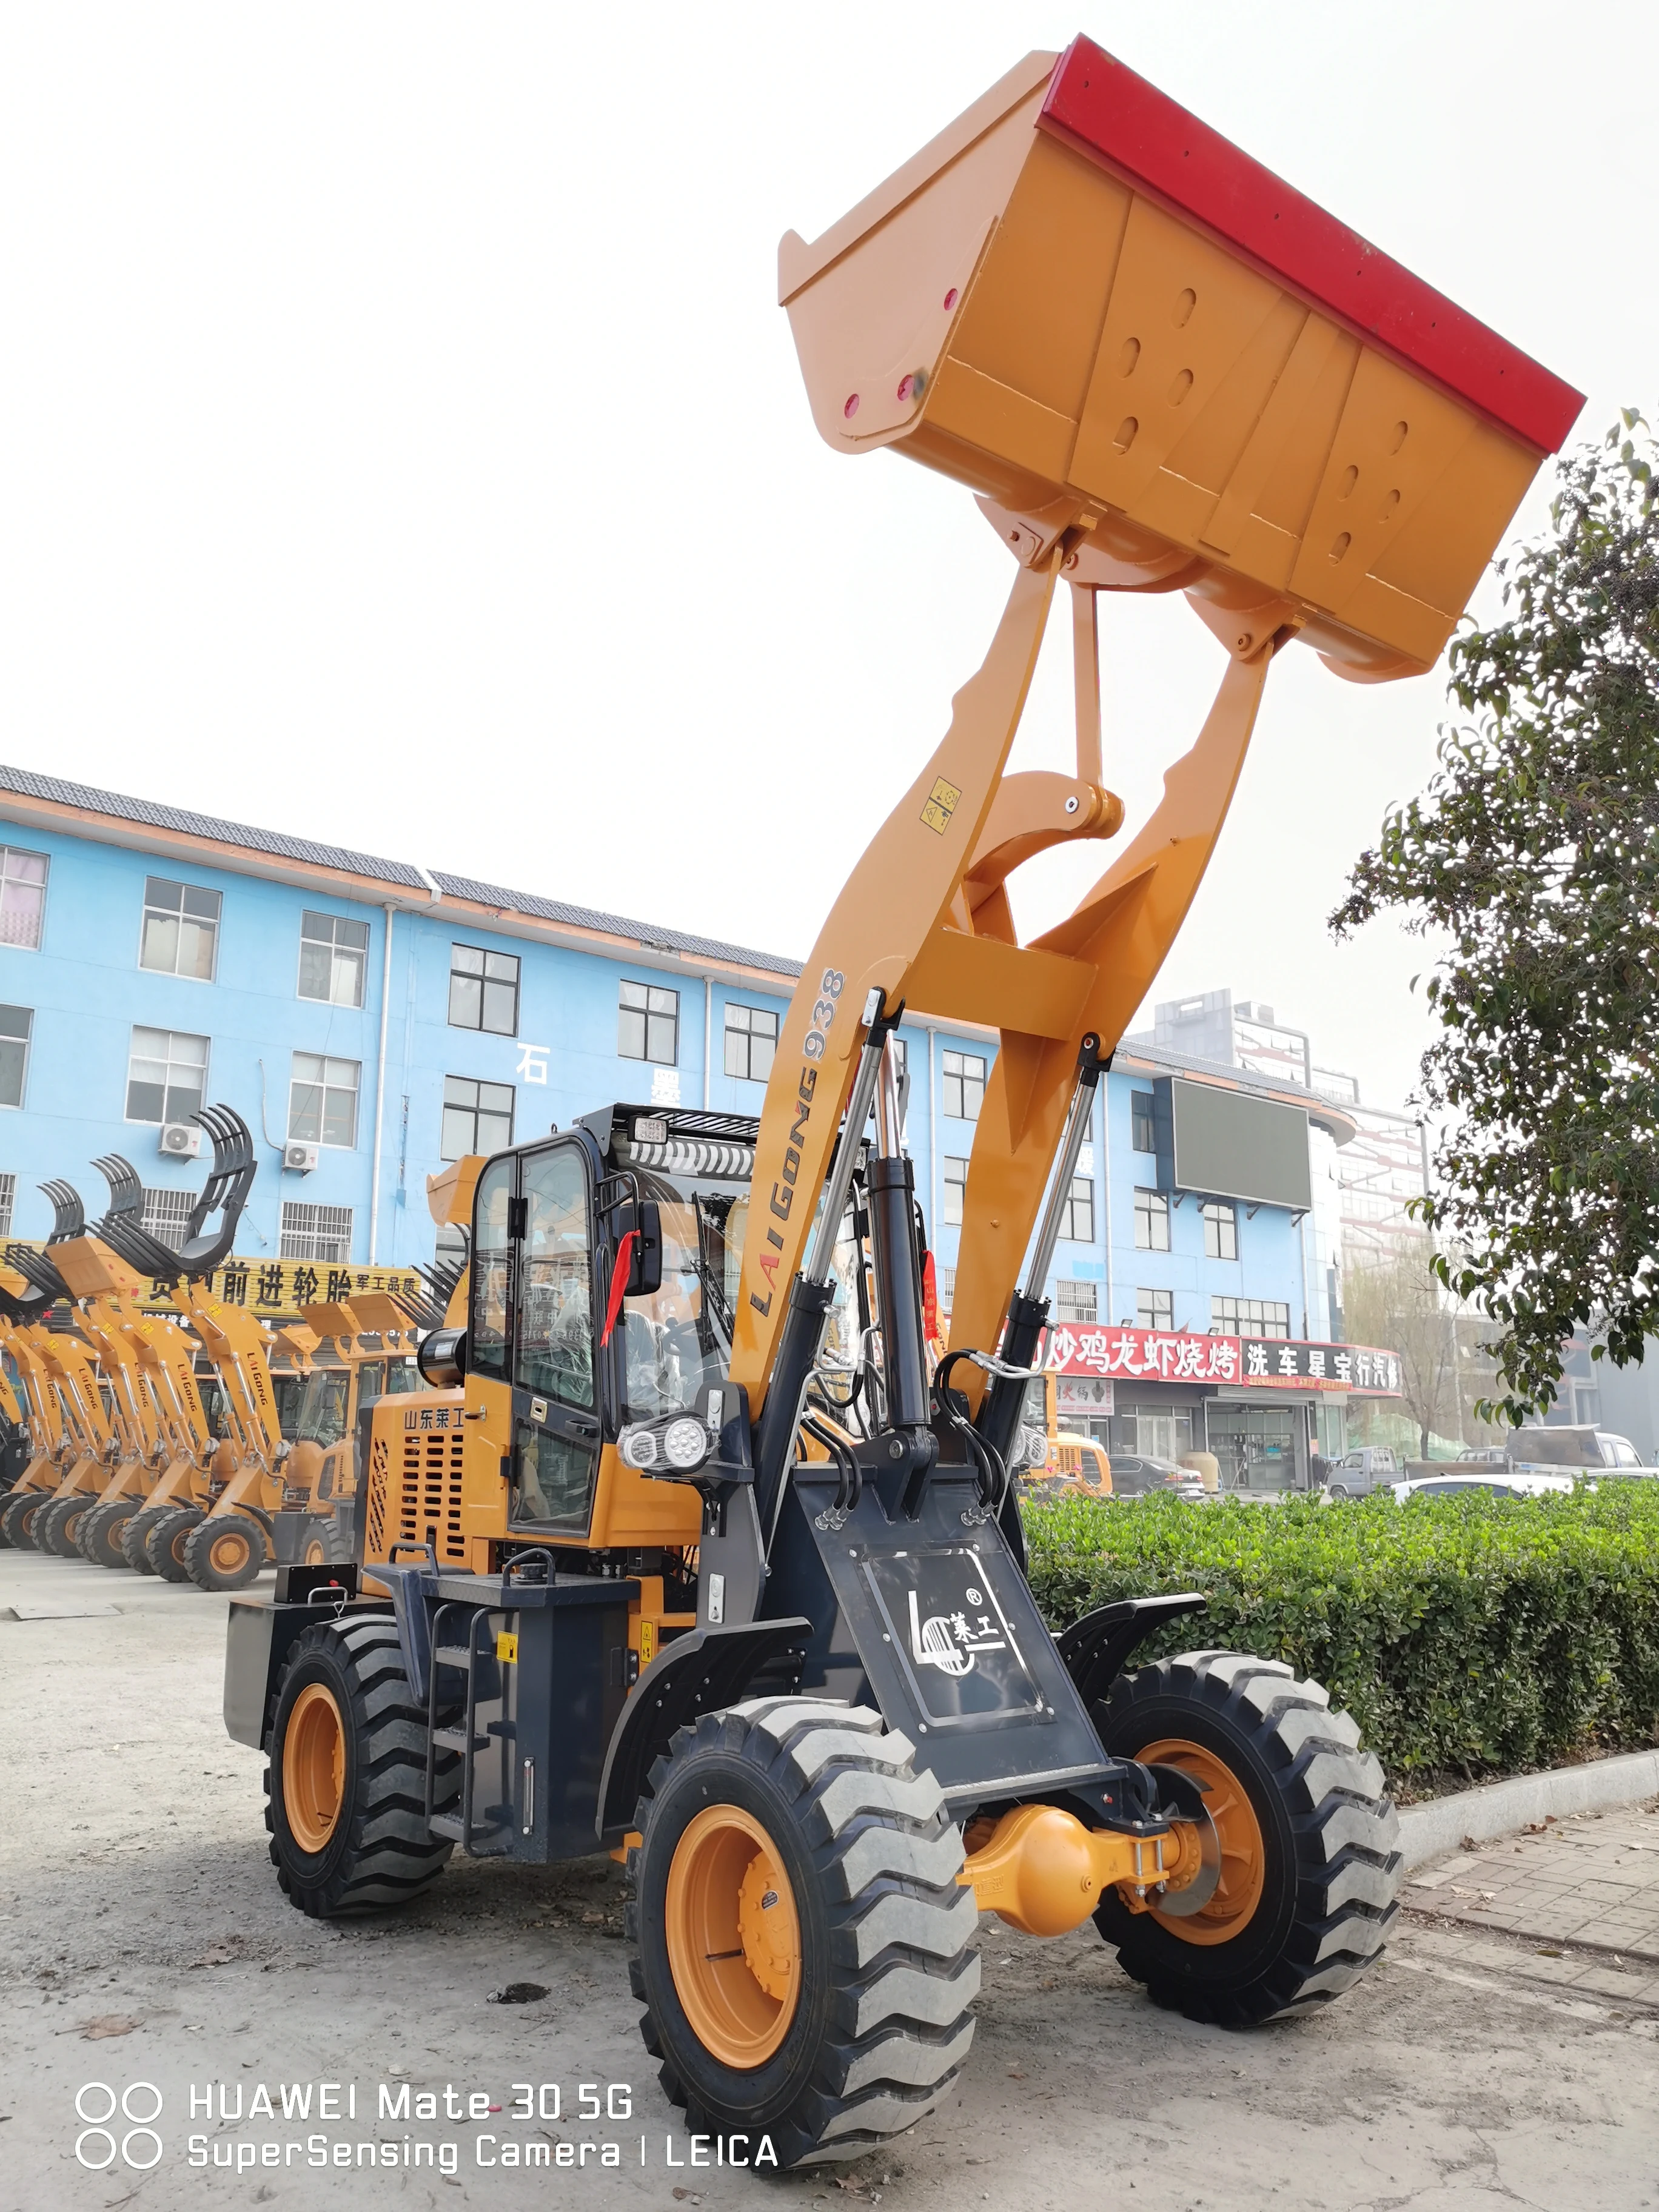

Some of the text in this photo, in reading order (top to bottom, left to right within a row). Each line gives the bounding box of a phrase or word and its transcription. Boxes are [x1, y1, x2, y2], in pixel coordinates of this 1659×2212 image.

[804, 968, 845, 1061] 938
[516, 1042, 551, 1085] 石
[651, 1068, 681, 1108] 墨
[149, 1261, 417, 1307] 前进轮胎 军工品质
[404, 1407, 464, 1430] 山东莱工
[950, 1611, 999, 1643] 莱工
